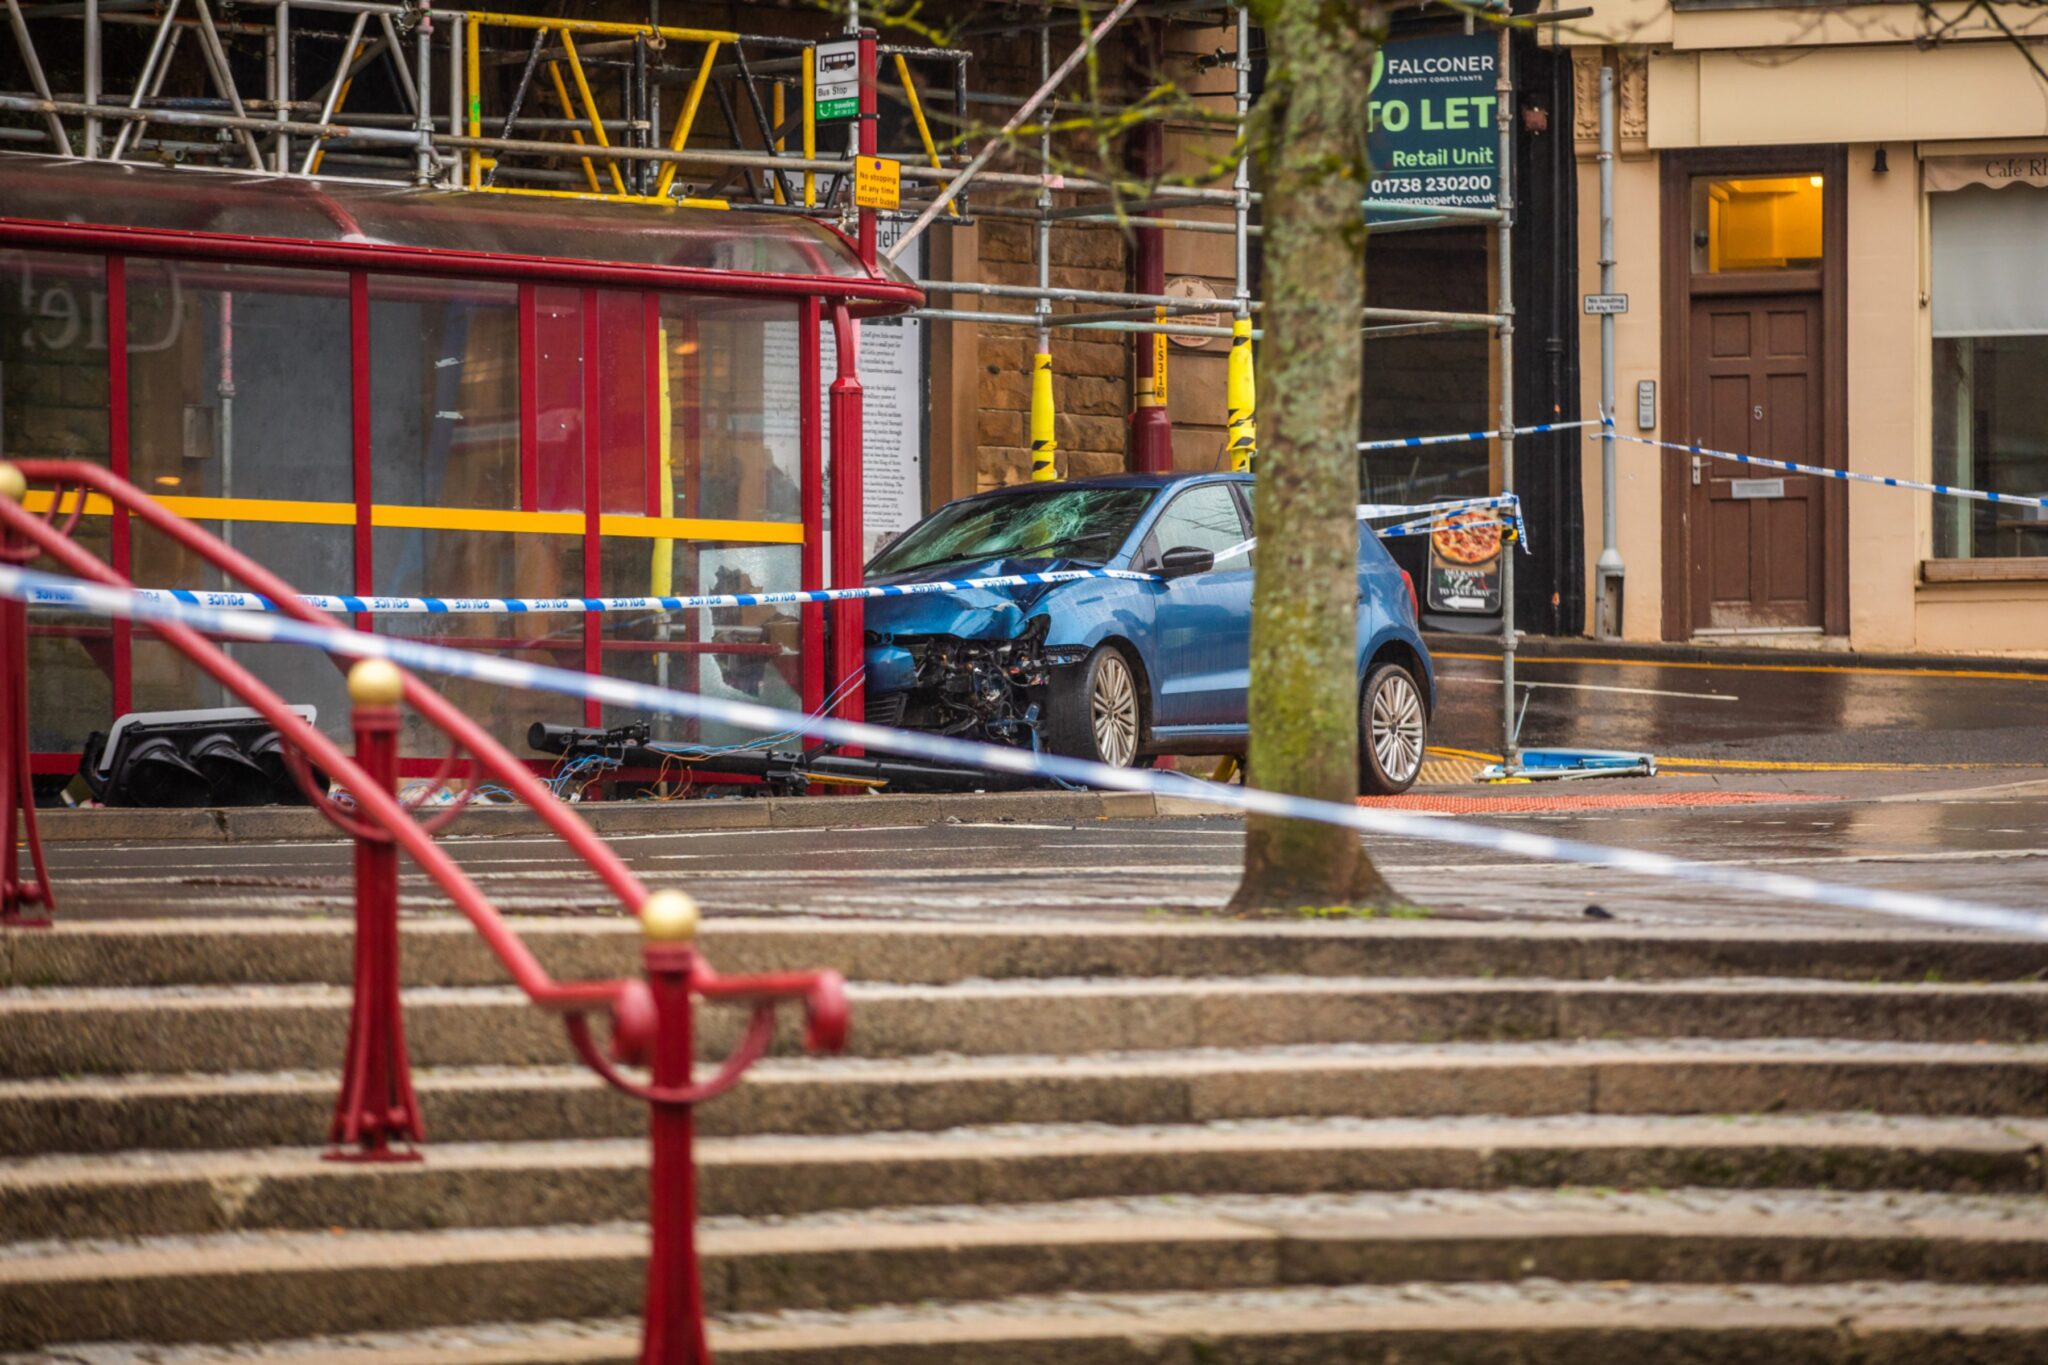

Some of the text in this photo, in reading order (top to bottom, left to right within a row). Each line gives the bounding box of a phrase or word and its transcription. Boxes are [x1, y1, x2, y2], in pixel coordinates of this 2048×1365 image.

[1388, 56, 1494, 75] FALCONER
[1388, 75, 1483, 85] PROPERTY CONSULTANTS
[818, 86, 848, 96] Bus Stop
[1421, 96, 1496, 131] LET
[1393, 147, 1494, 167] Retail Unit
[1985, 157, 2023, 178] Café
[860, 171, 897, 185] No stopping
[861, 184, 867, 192] at
[869, 186, 879, 195] any
[1371, 175, 1492, 194] 01738 230200
[1368, 193, 1496, 206] nerproperty.co.uk
[1753, 405, 1763, 420] 5
[207, 594, 246, 606] POLICE
[764, 593, 796, 603] POLICE
[838, 589, 870, 600] POLICE
[374, 598, 410, 609] POLICE
[455, 599, 490, 609] POLICE
[535, 599, 569, 609] POLICE
[612, 598, 646, 609] POLICE
[689, 596, 722, 606] POLICE
